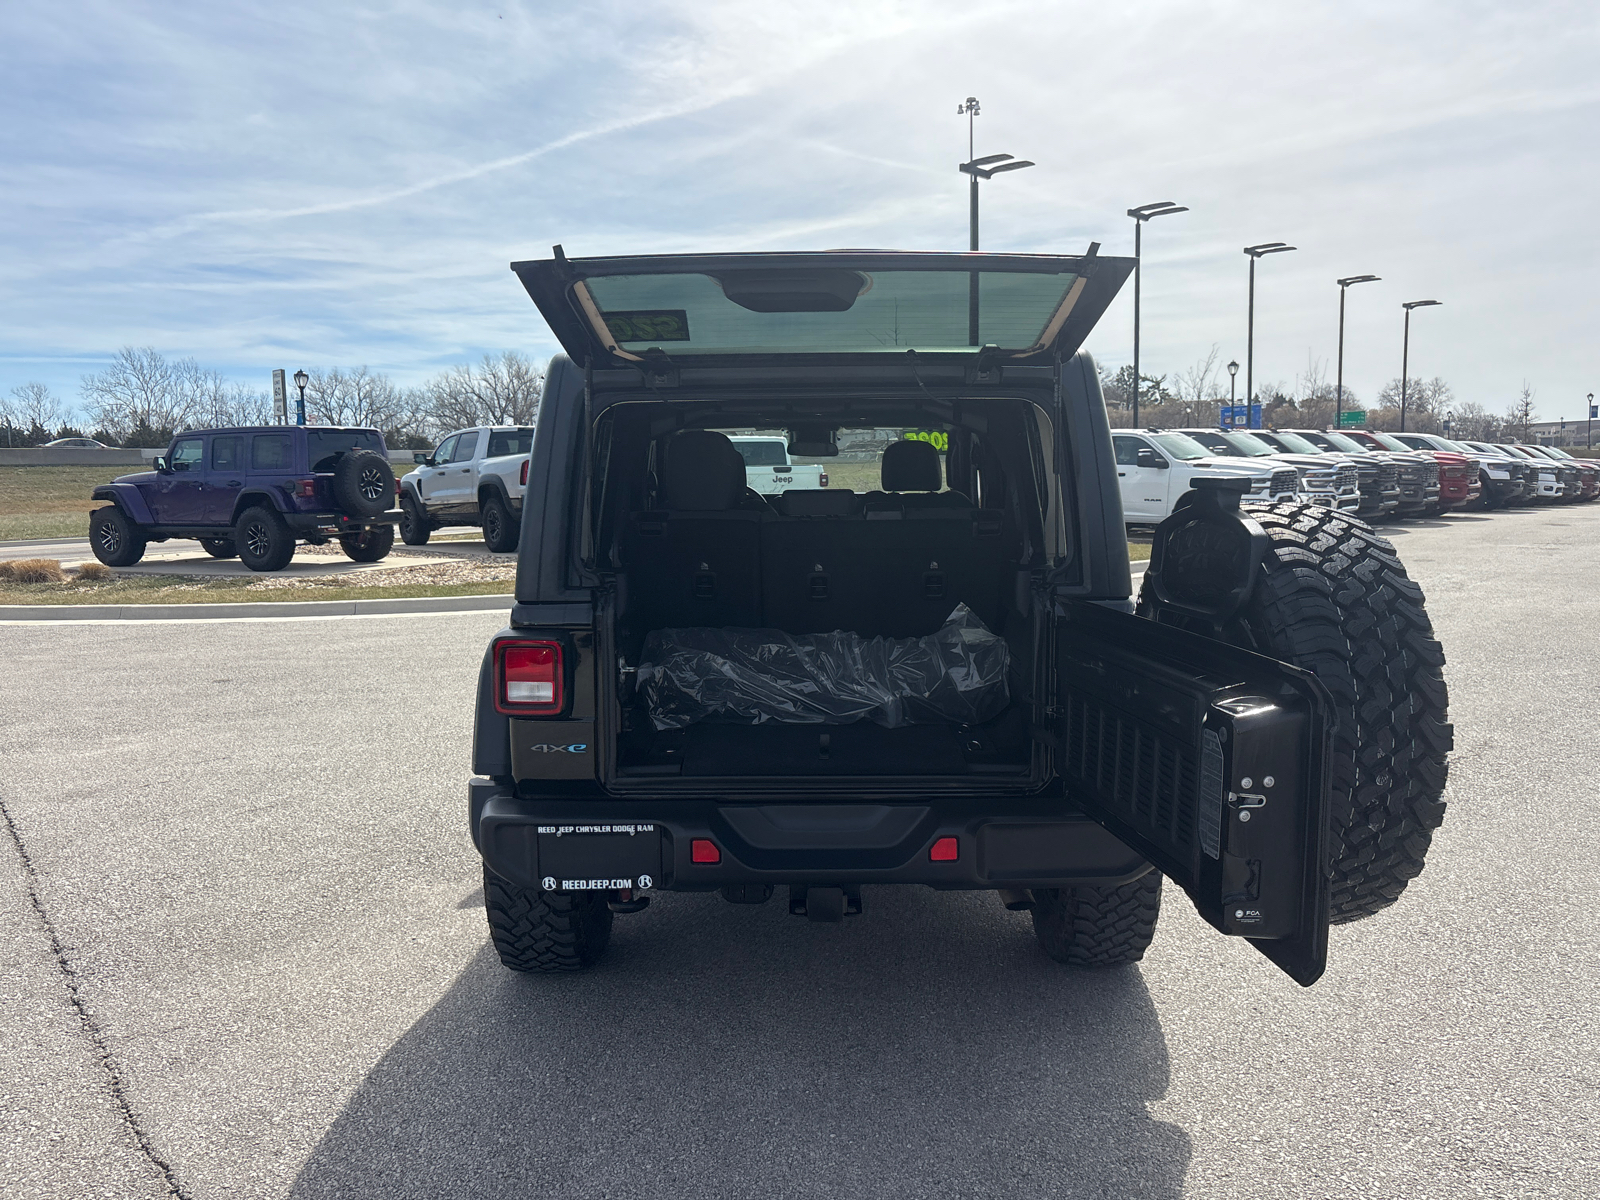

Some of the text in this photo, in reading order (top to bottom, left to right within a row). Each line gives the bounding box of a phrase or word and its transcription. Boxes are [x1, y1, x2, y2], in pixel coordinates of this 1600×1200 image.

[772, 475, 793, 484] Jeep
[538, 826, 556, 834] REED
[576, 825, 611, 833] CHRYSLER
[637, 824, 654, 832] RAM
[562, 879, 632, 890] REEDJEEP.COM
